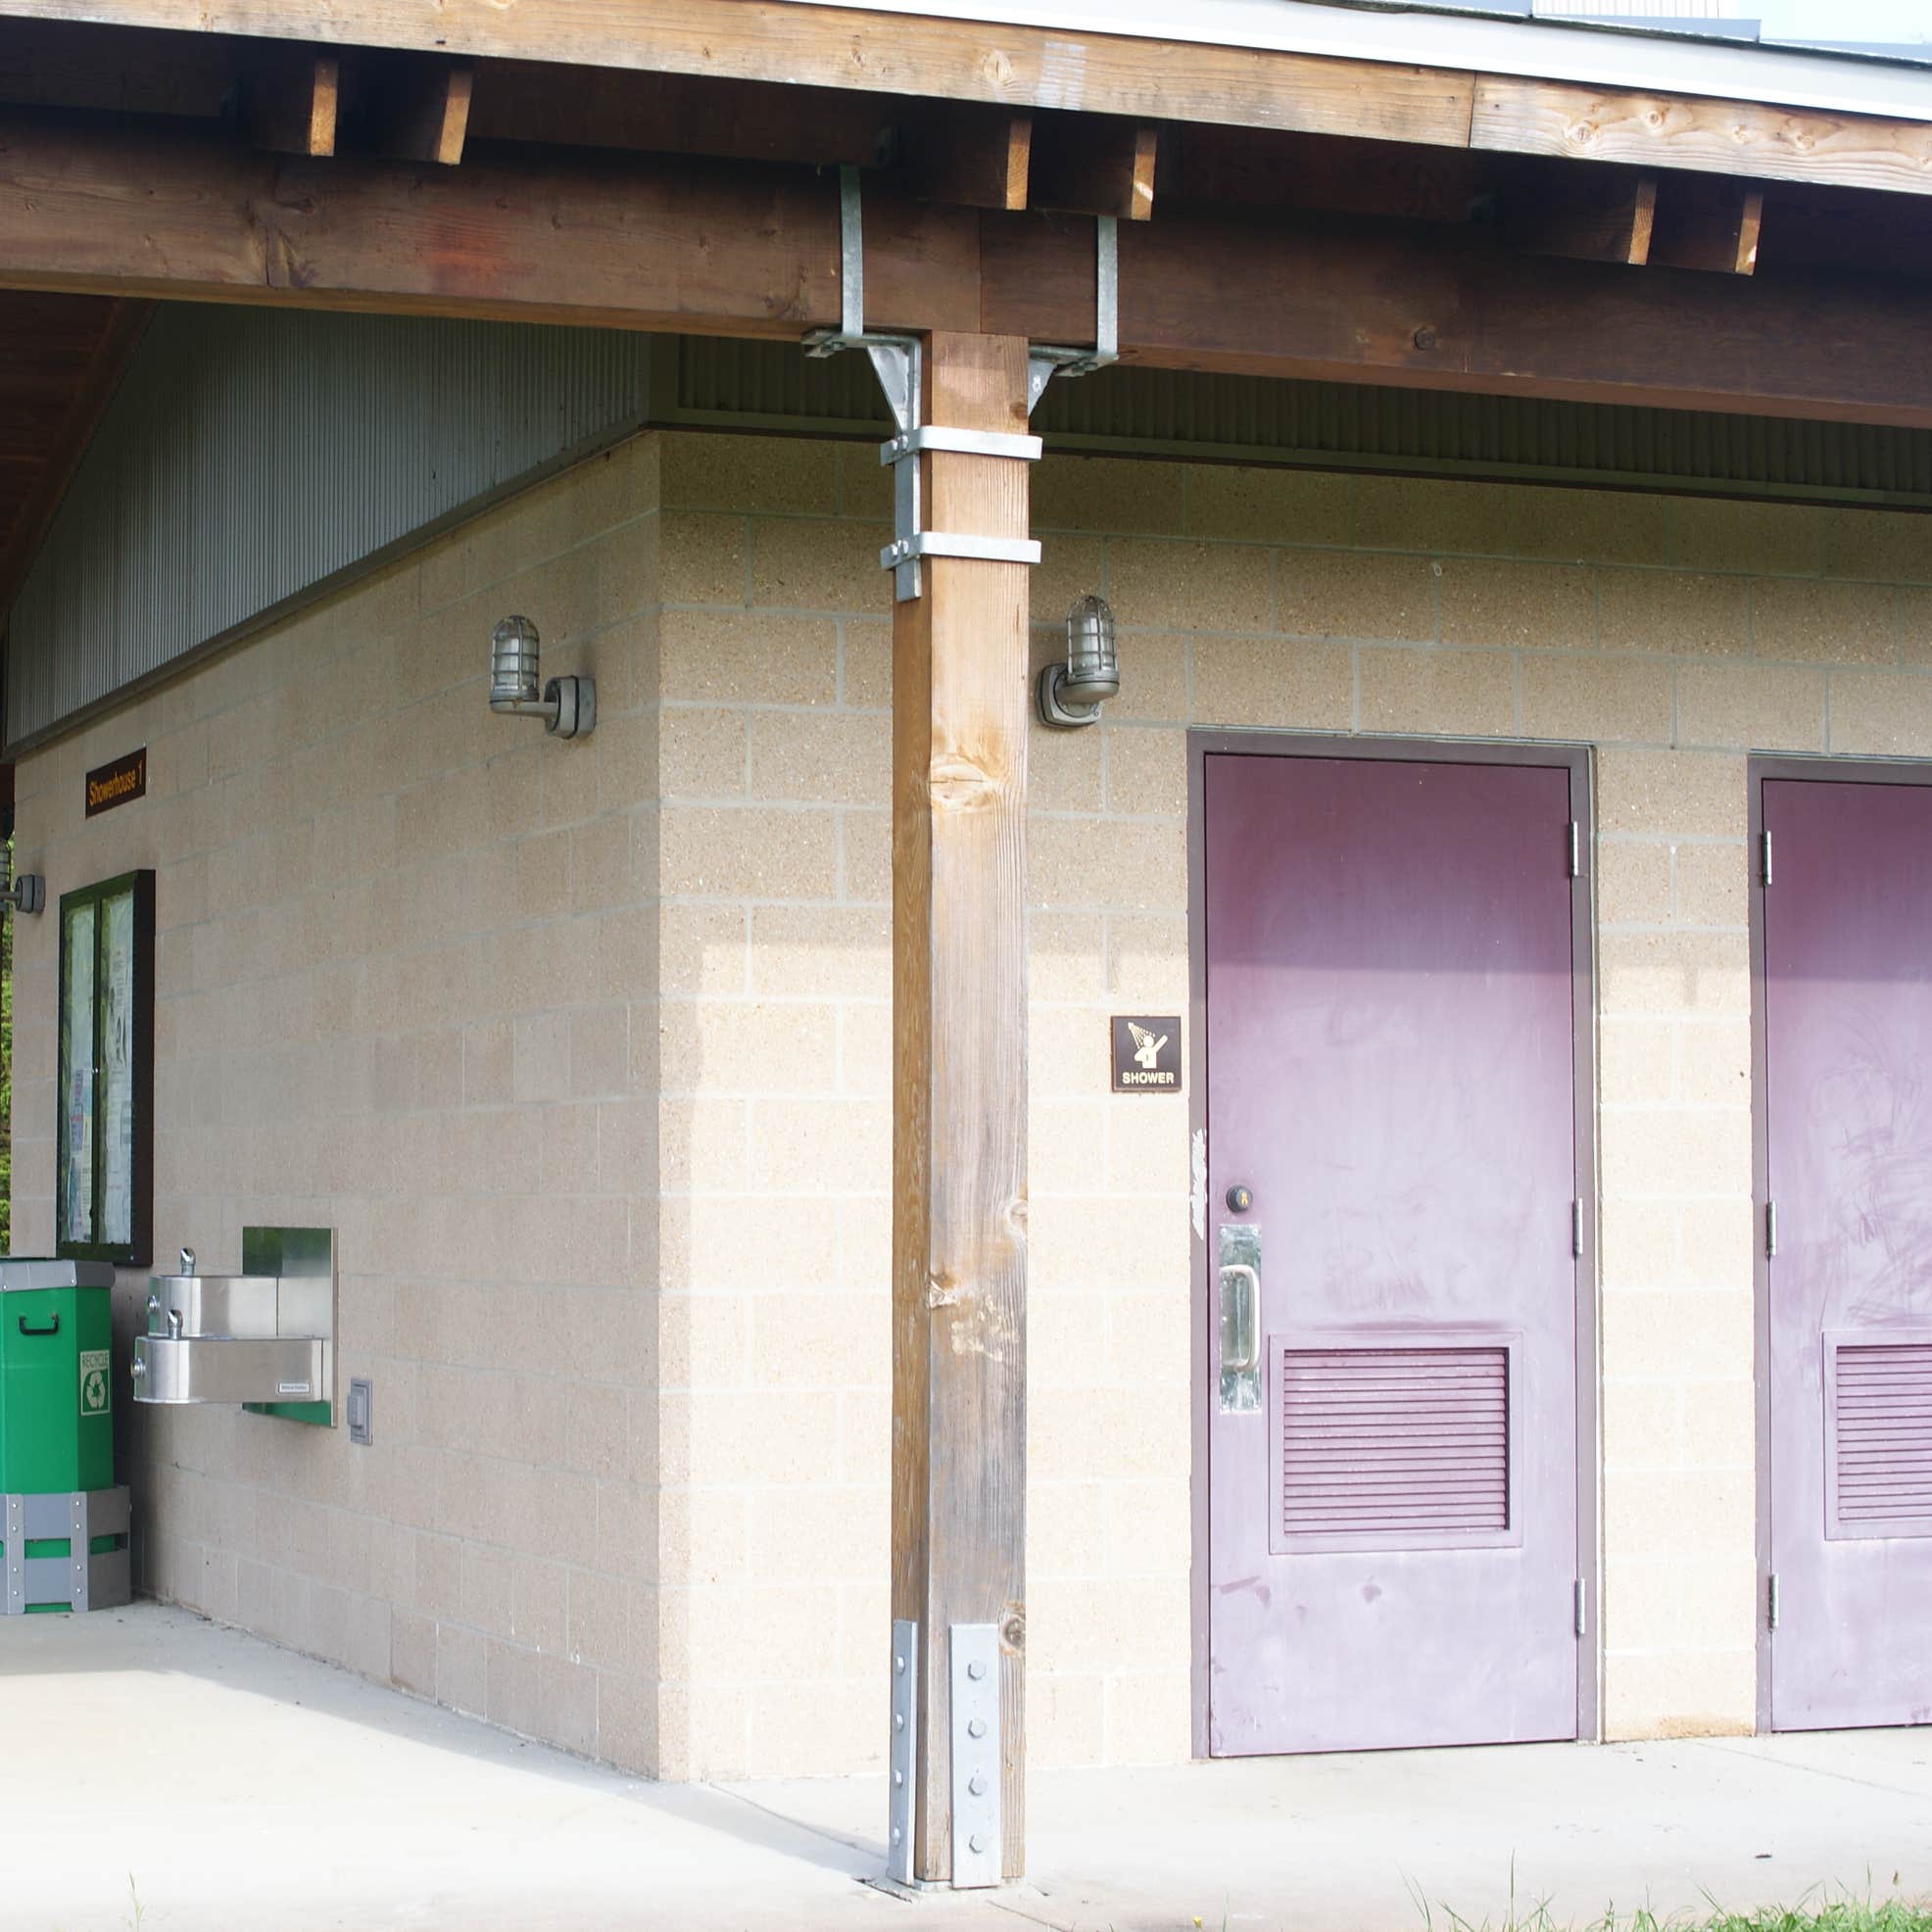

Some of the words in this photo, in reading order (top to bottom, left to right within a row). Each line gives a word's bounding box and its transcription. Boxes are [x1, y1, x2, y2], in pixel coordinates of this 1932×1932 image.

[89, 769, 135, 806] Showerhouse
[137, 759, 143, 785] 1
[1122, 1071, 1175, 1085] SHOWER
[81, 1353, 109, 1368] RECYCLE
